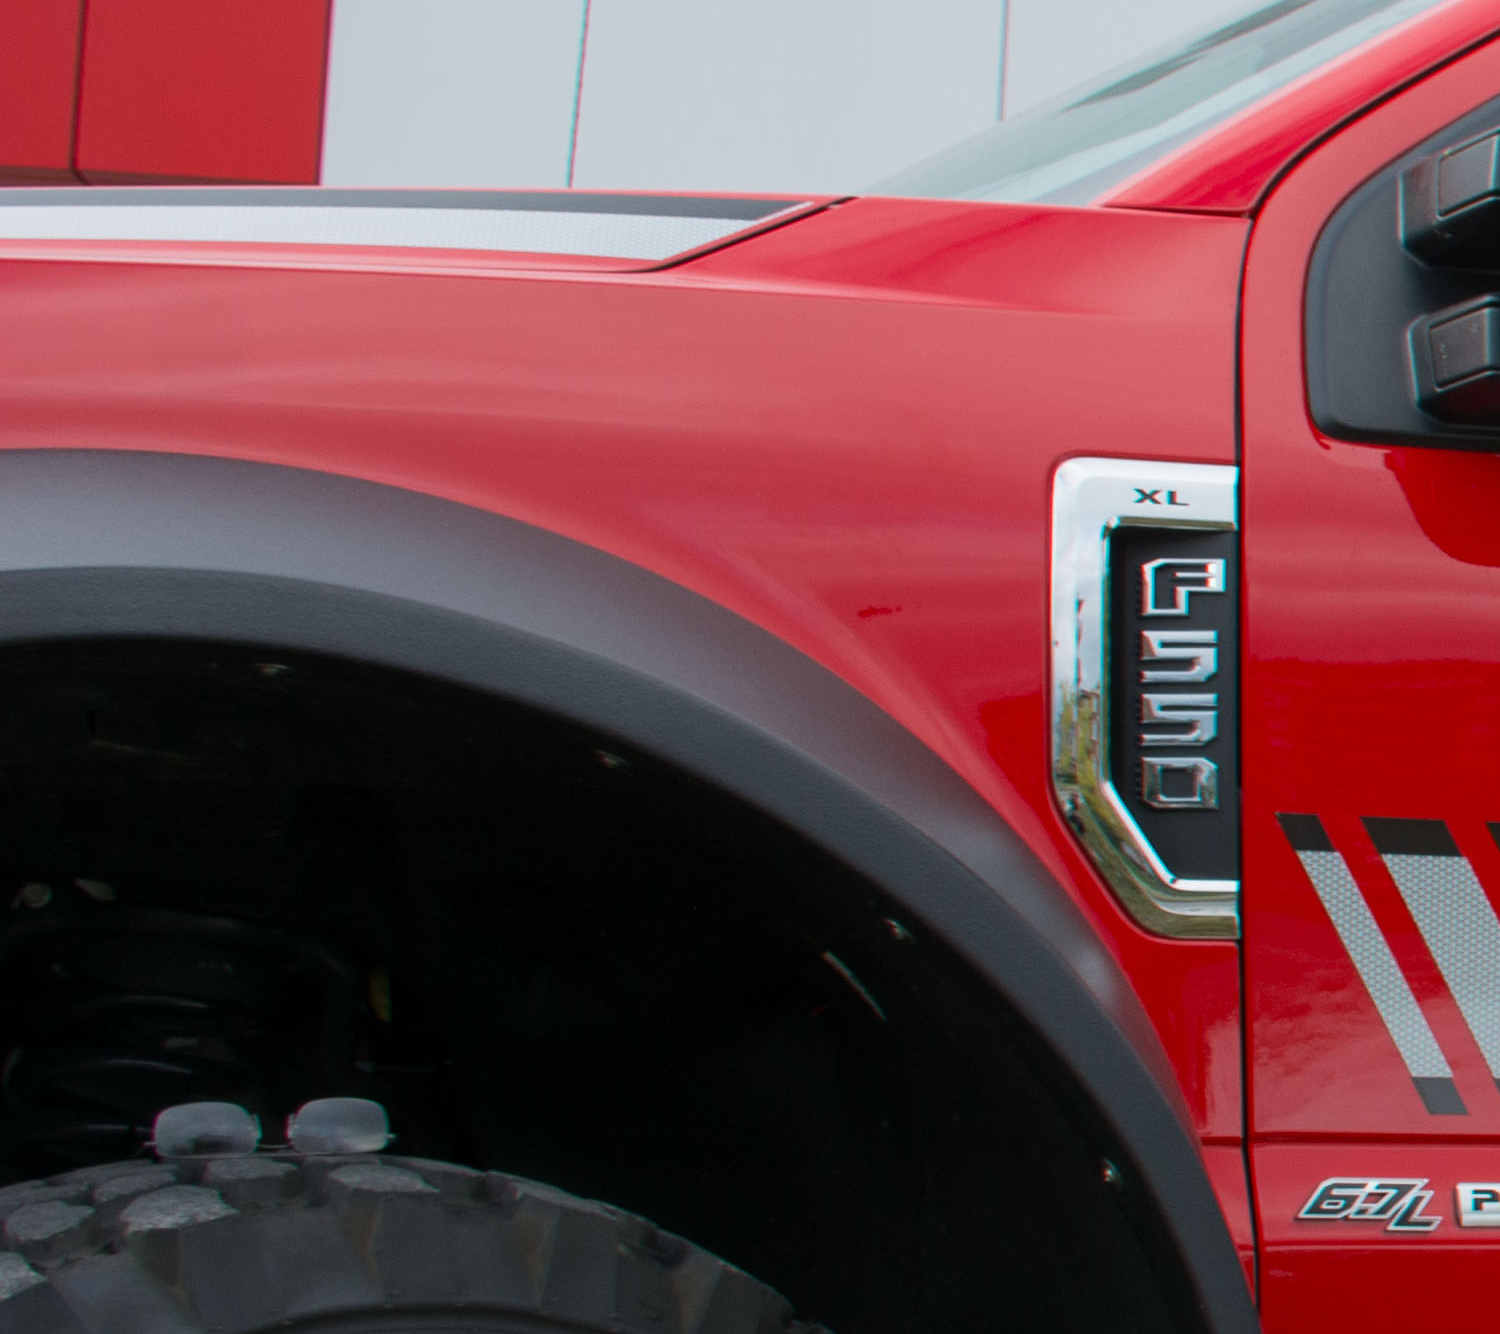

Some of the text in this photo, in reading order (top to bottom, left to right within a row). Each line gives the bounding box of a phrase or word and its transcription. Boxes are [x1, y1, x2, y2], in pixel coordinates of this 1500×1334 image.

[1132, 488, 1190, 506] XL
[1138, 556, 1227, 809] F550
[1296, 1177, 1442, 1231] 6.7L
